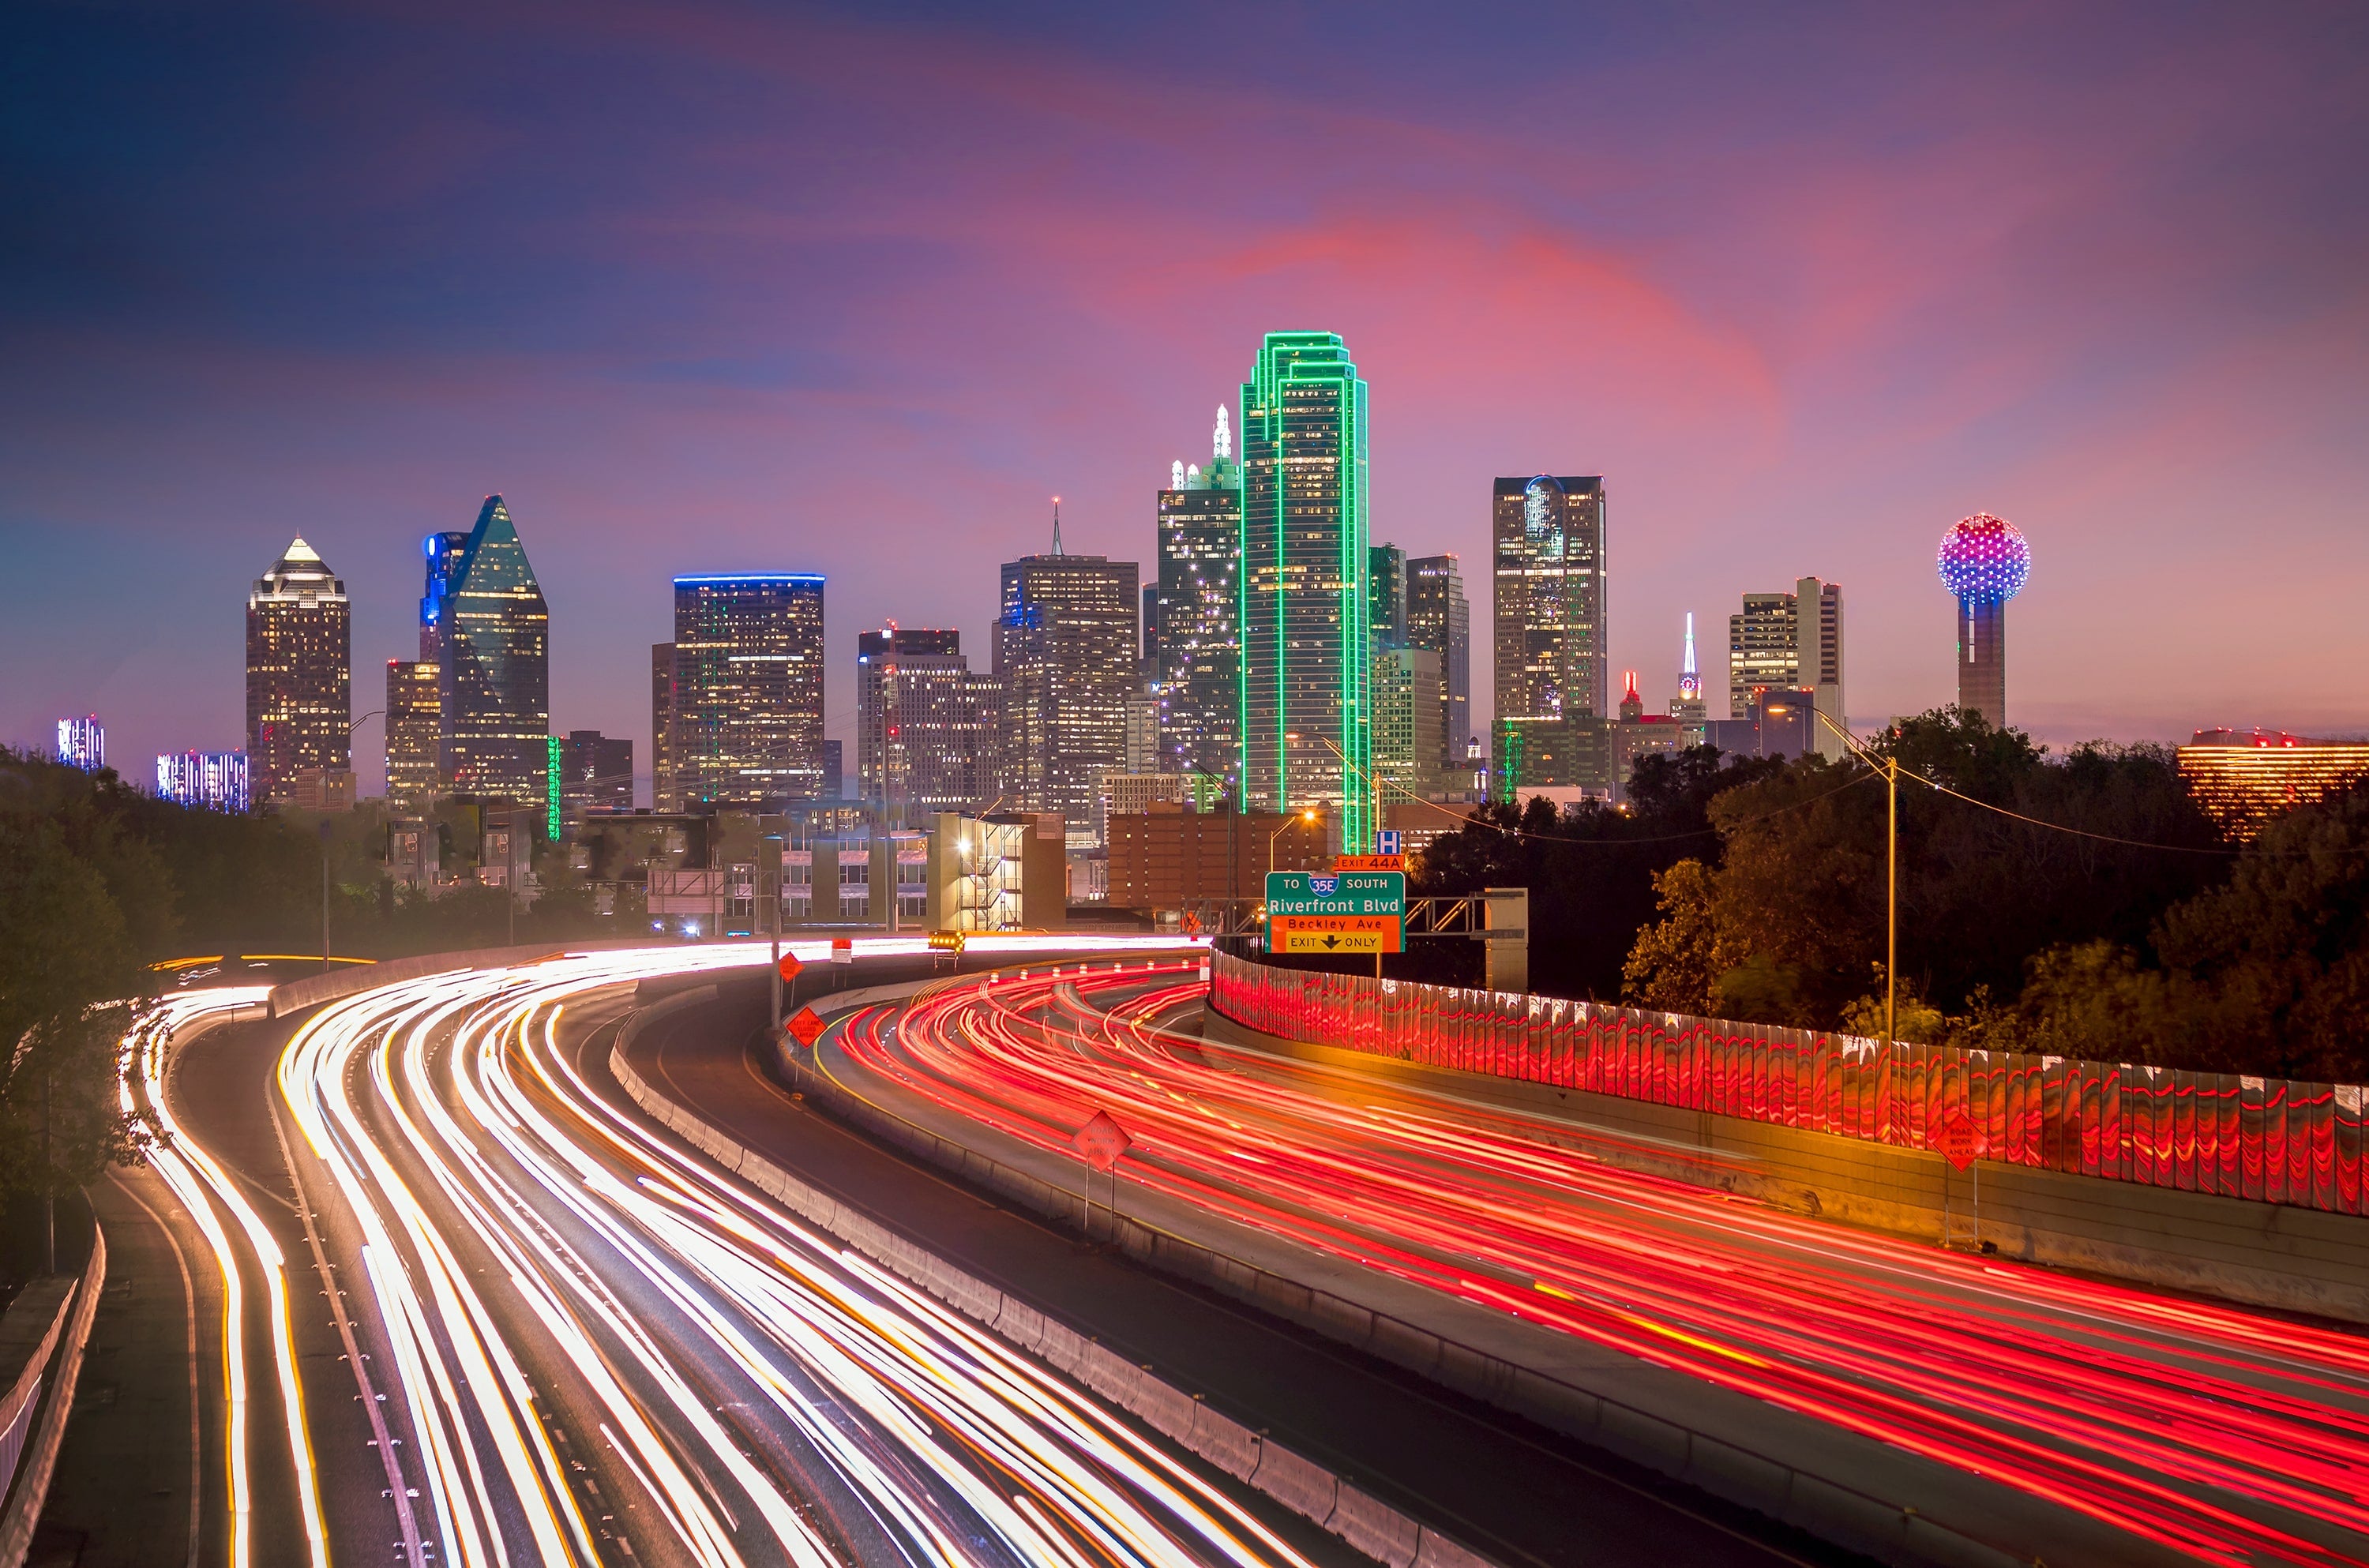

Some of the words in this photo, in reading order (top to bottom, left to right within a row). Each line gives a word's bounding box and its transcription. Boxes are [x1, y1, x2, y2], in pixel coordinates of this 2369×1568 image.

[1380, 832, 1397, 853] H
[1369, 857, 1400, 868] 44A
[1283, 879, 1300, 889] TO
[1312, 880, 1335, 892] 35E
[1346, 879, 1387, 889] SOUTH
[1270, 899, 1354, 912] Riverfront
[1364, 899, 1398, 912] Blvd
[1288, 919, 1346, 931] Beckley
[1357, 919, 1382, 929] Ave
[1290, 937, 1316, 947] EXIT
[1345, 937, 1376, 947] ONLY
[1949, 1148, 1976, 1157] AHEAD
